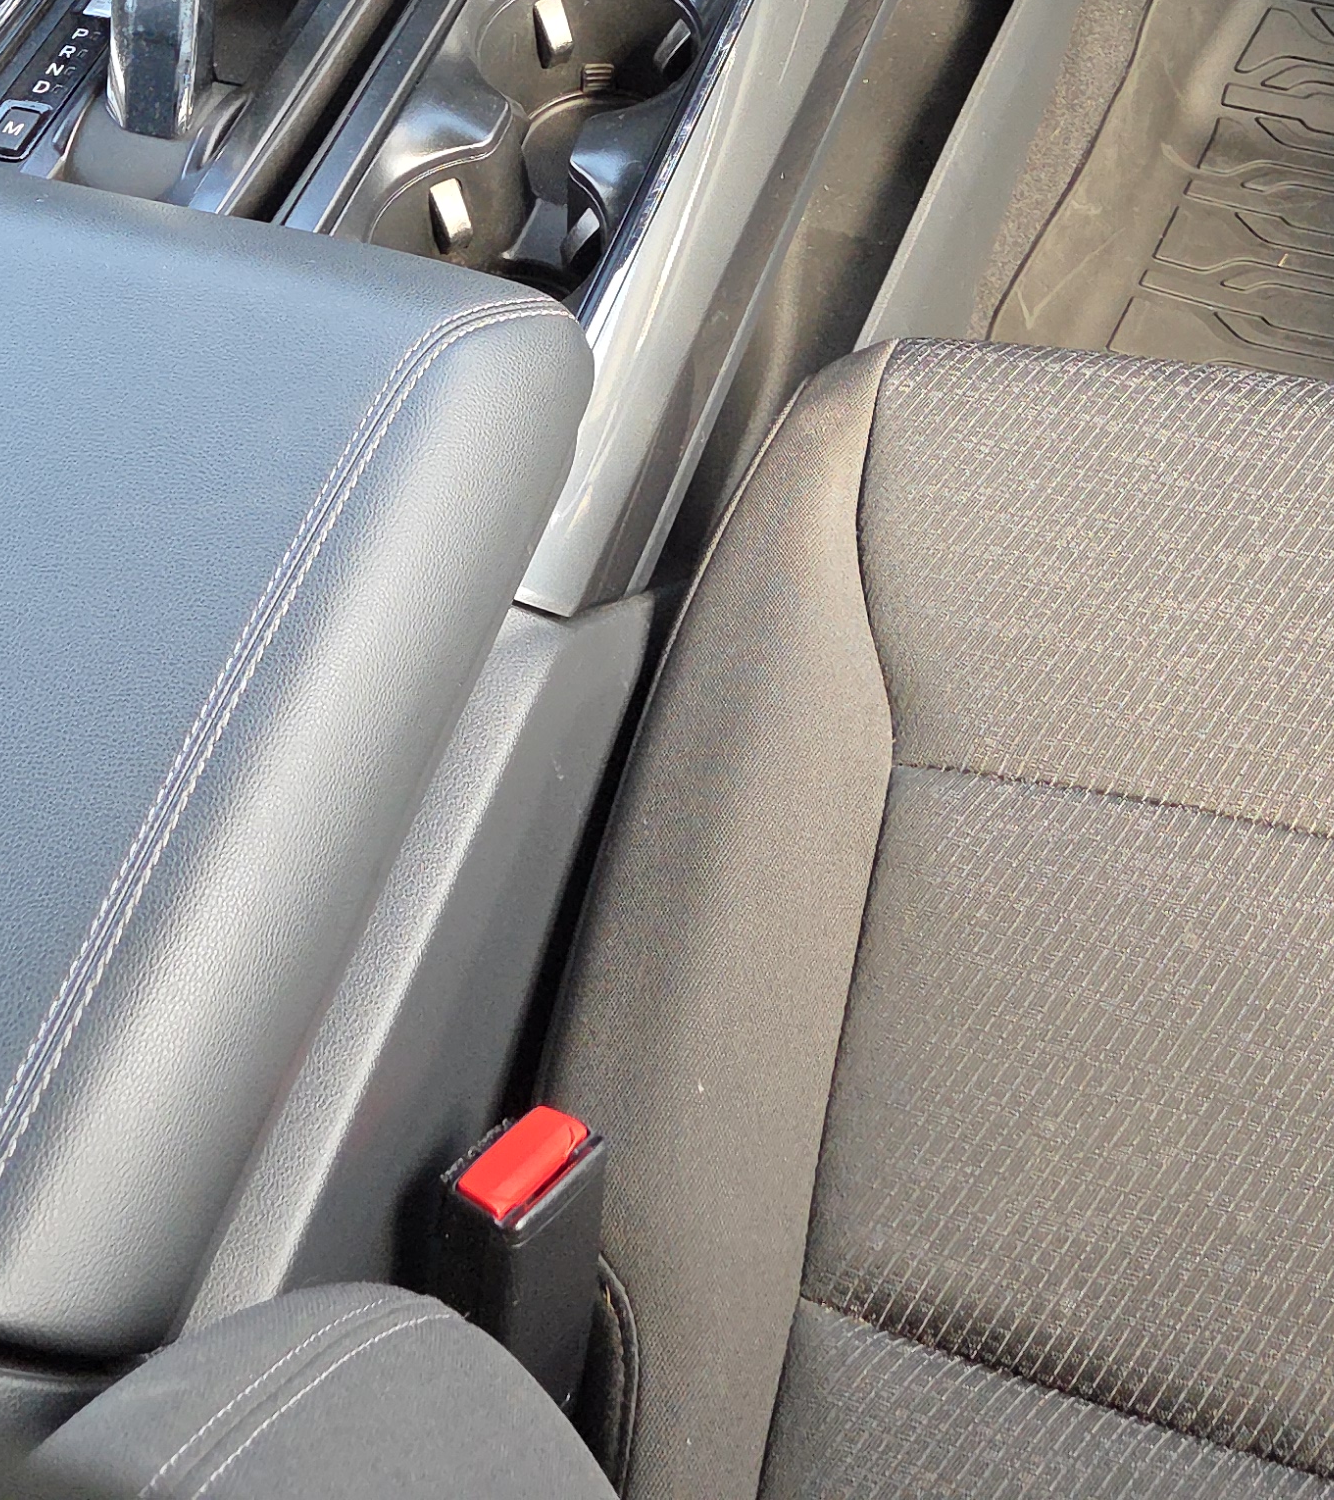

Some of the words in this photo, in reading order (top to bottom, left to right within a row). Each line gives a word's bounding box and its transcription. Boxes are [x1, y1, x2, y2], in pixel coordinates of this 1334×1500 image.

[71, 28, 89, 40] P
[58, 45, 77, 59] R
[45, 62, 65, 76] N
[32, 80, 50, 94] D
[2, 120, 25, 136] M
